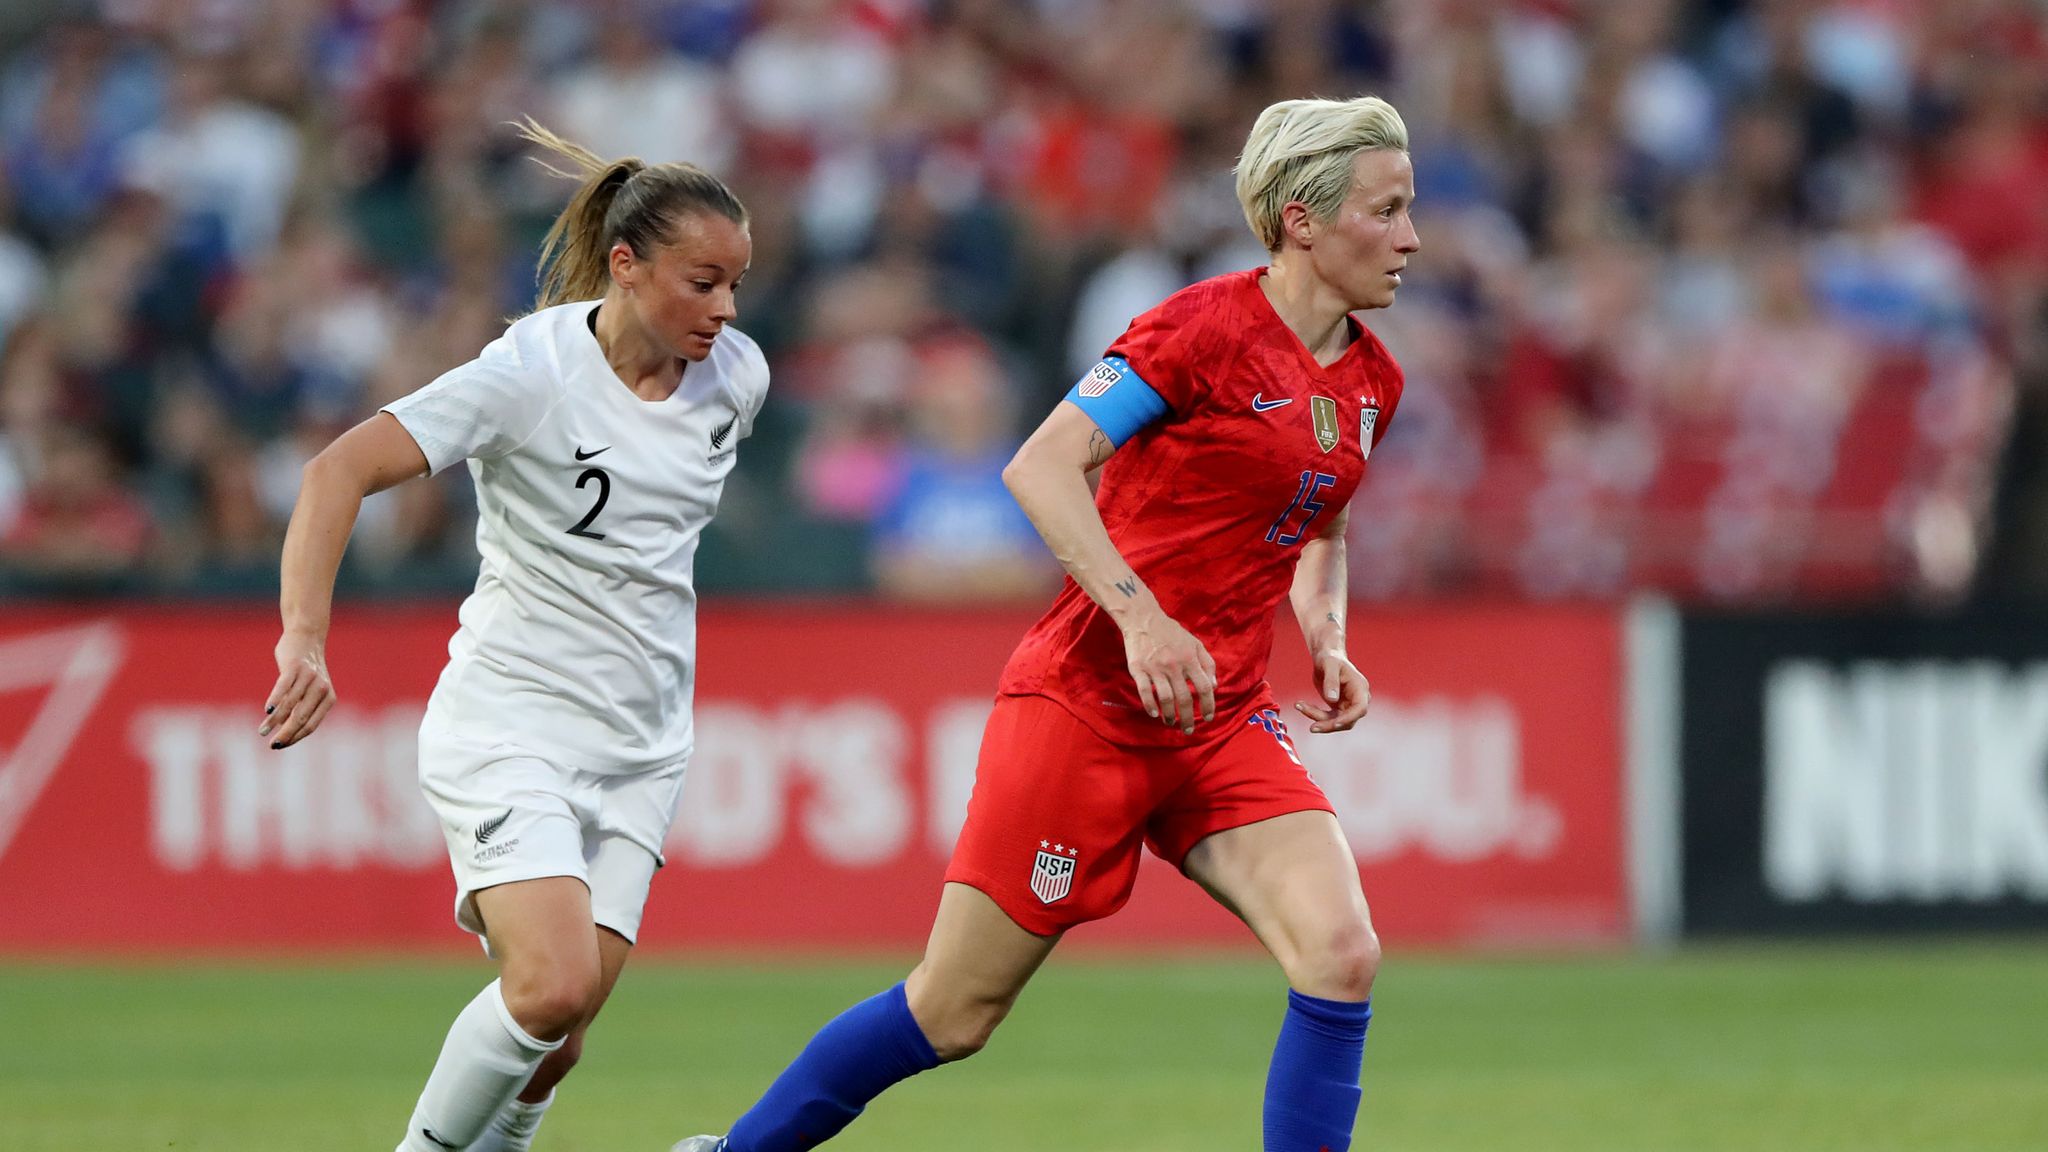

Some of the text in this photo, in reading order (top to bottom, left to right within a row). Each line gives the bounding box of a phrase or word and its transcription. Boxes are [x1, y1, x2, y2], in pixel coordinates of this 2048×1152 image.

[1094, 363, 1119, 383] USA
[564, 468, 611, 541] 2
[1264, 470, 1337, 546] 15
[131, 705, 452, 870] THIS
[1038, 854, 1073, 877] USA
